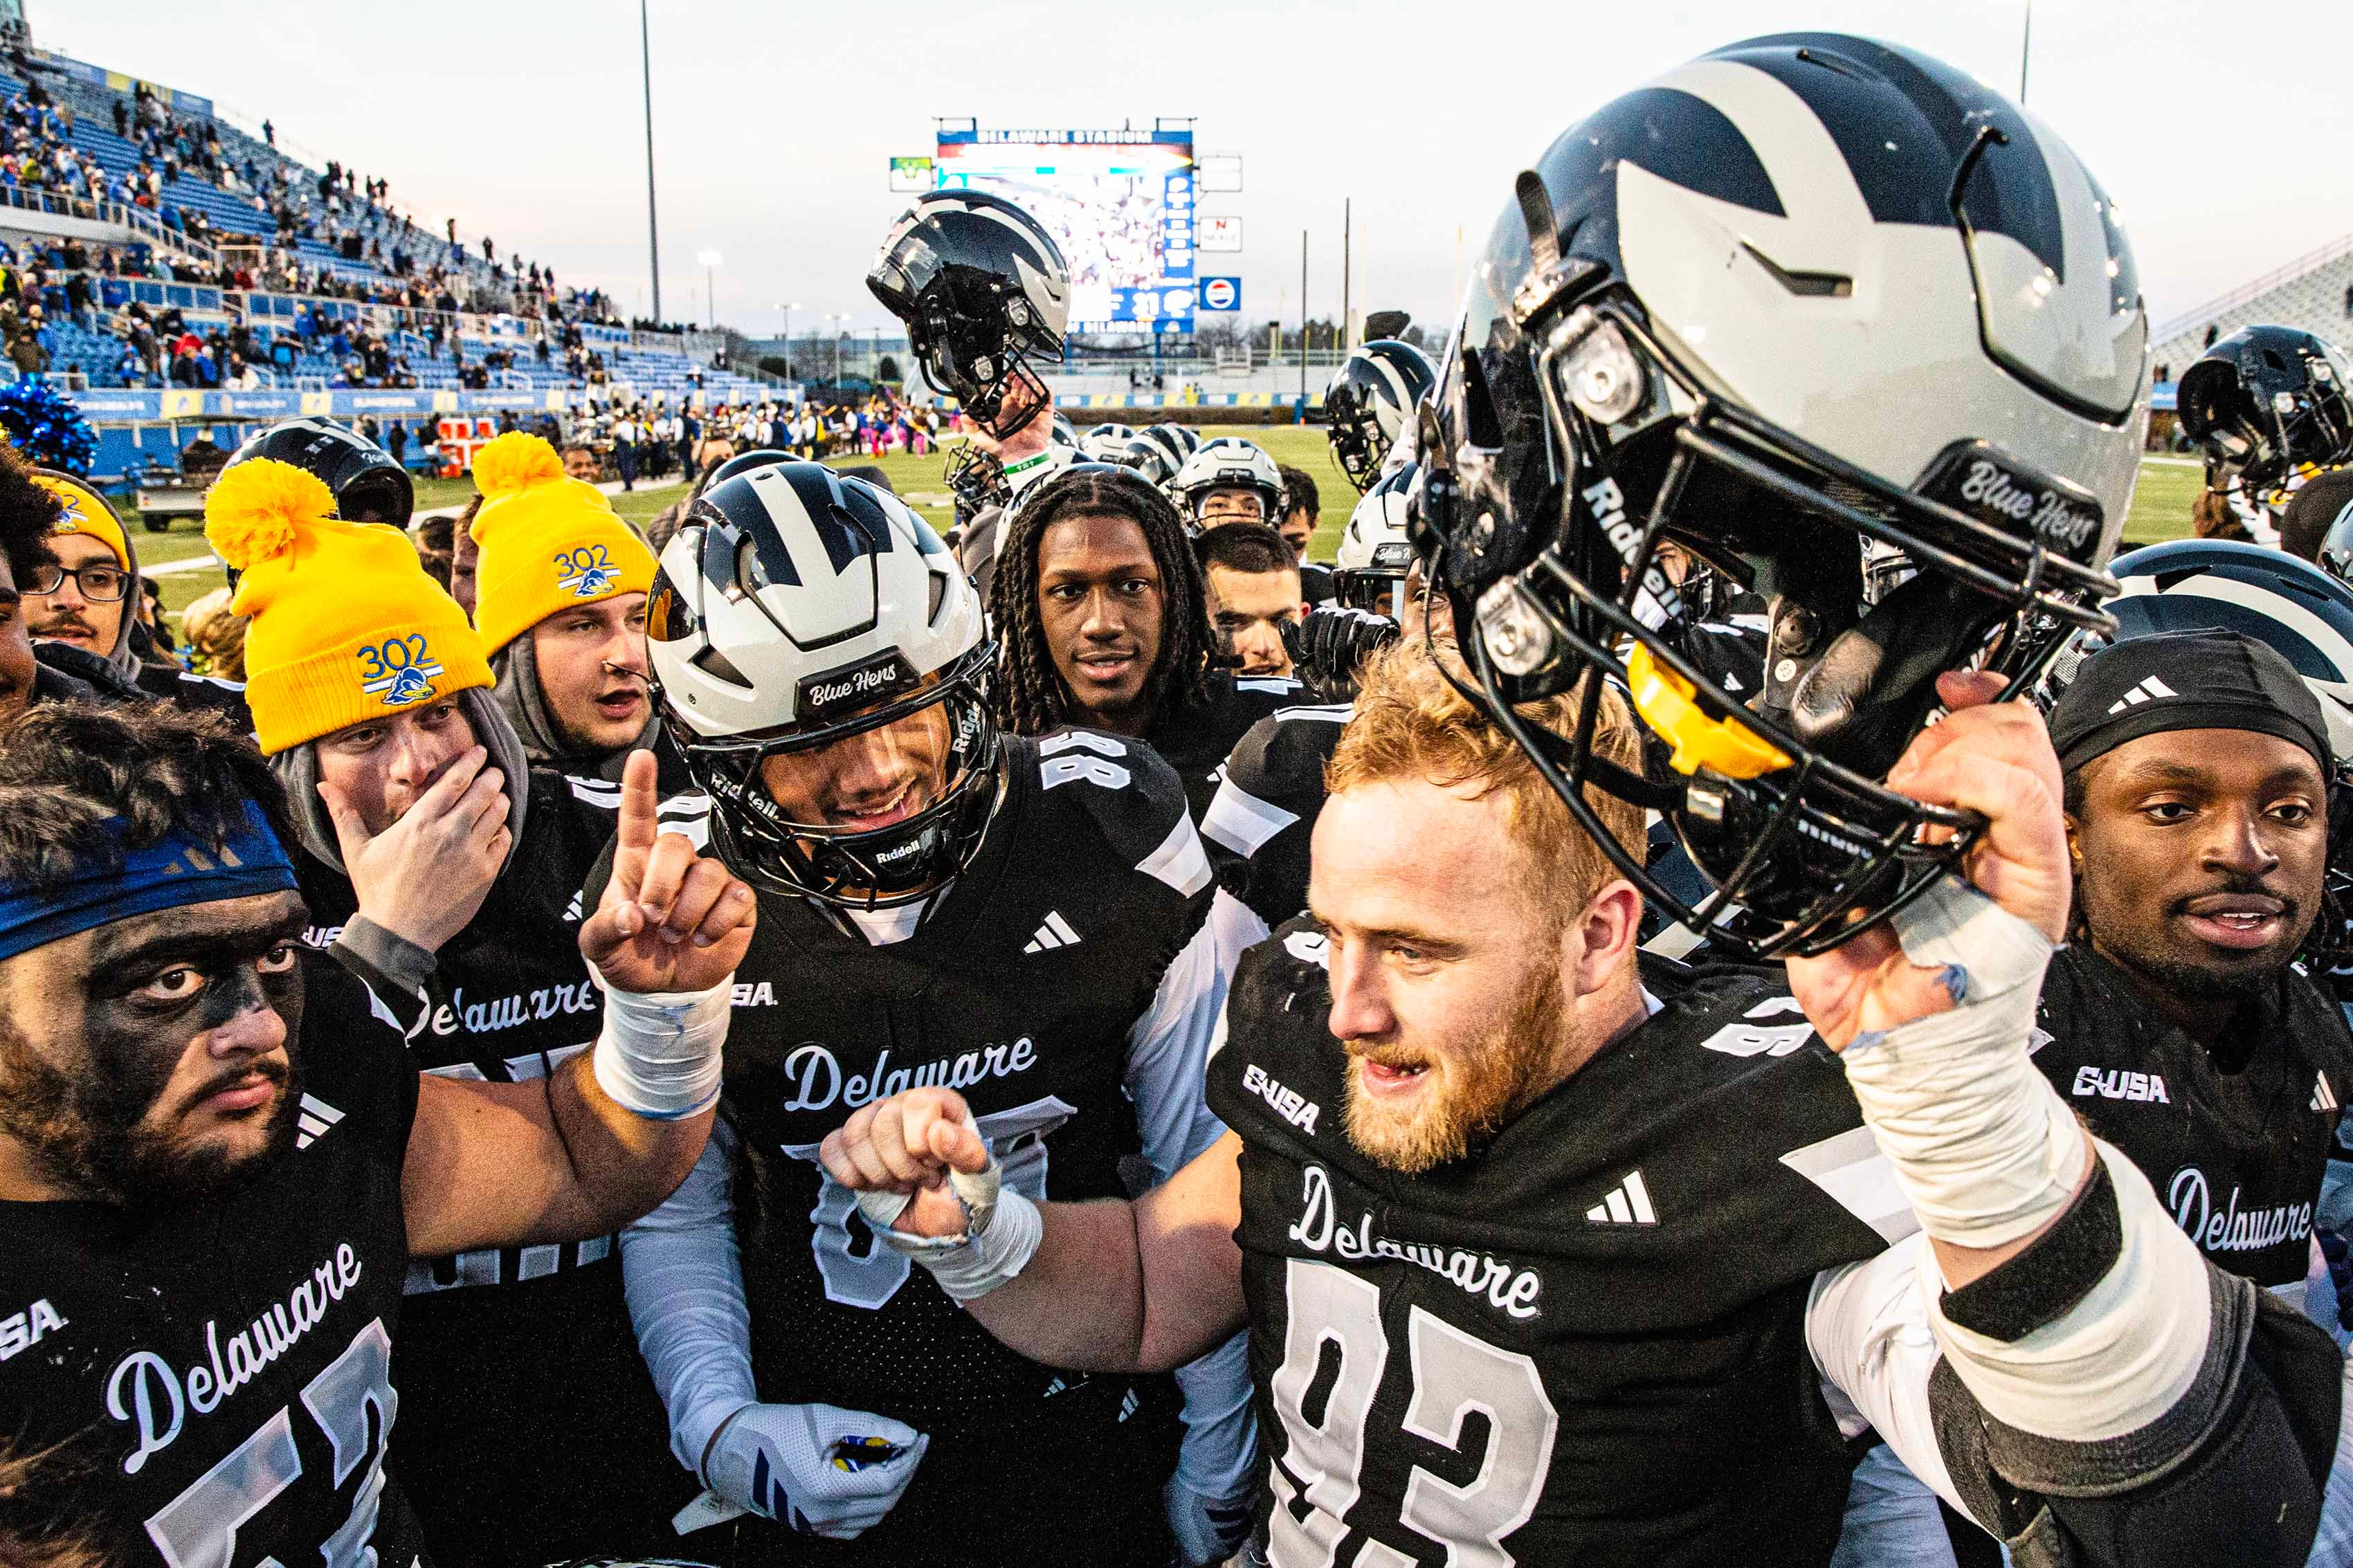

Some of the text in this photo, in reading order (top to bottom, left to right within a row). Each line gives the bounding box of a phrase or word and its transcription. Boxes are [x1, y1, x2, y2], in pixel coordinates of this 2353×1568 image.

[1073, 131, 1152, 144] STADIUM
[1960, 460, 2096, 548] Blue Hens
[554, 545, 613, 577] 302
[357, 633, 435, 678] 302
[809, 664, 896, 706] Blue Hens
[875, 840, 920, 864] Riddell
[783, 1037, 1039, 1112] Delaware
[2170, 1167, 2313, 1251] Delaware
[107, 1243, 361, 1475] Delaware
[1266, 1257, 1559, 1568] 93
